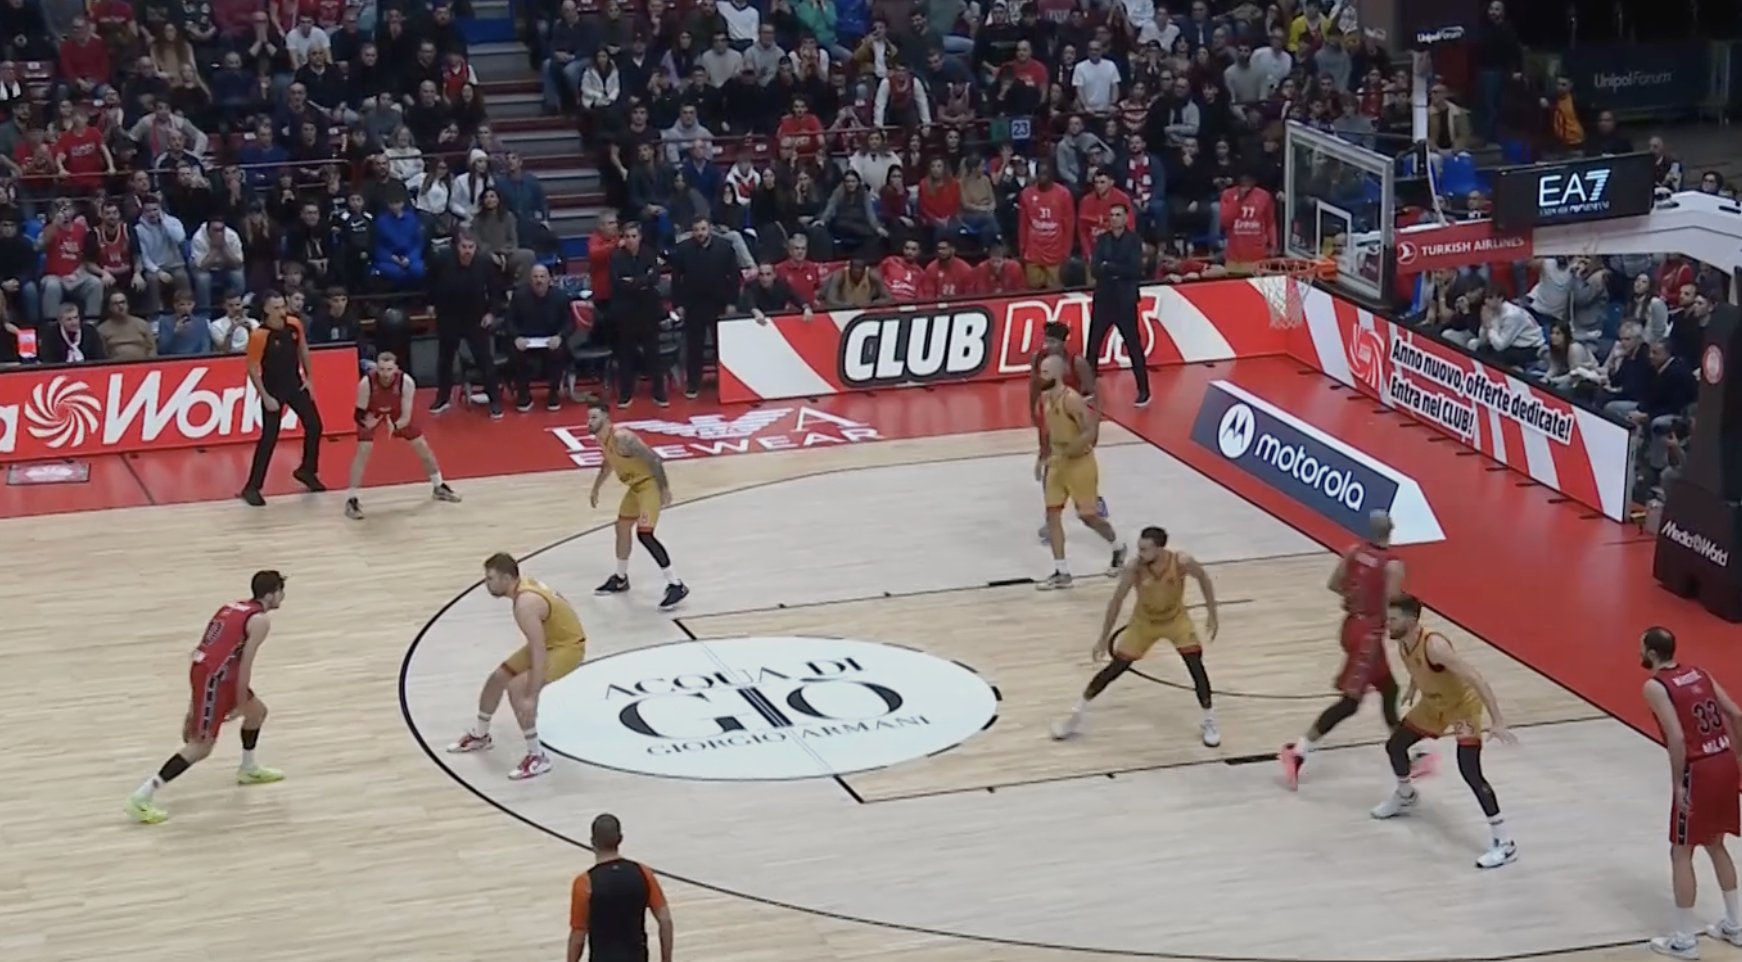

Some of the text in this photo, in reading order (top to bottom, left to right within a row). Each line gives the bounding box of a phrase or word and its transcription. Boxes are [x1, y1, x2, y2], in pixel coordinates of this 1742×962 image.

[1594, 71, 1672, 93] UnipolForum
[1012, 121, 1029, 137] 23
[1539, 169, 1610, 206] EA7
[1421, 236, 1525, 257] TURKISH AIRLINES
[844, 312, 988, 381] CLUB
[1391, 339, 1423, 370] Anno
[1424, 356, 1464, 393] nuovo,
[1466, 374, 1509, 412] offerte
[1511, 395, 1572, 441] dedicate!
[1391, 377, 1476, 435] Entra nel CLUB!
[569, 428, 884, 467] EEWEAR
[1254, 433, 1366, 511] motorola
[605, 657, 865, 700] ACQUA DI
[646, 715, 932, 755] GIORGIO ARMANI
[1692, 698, 1722, 734] 33
